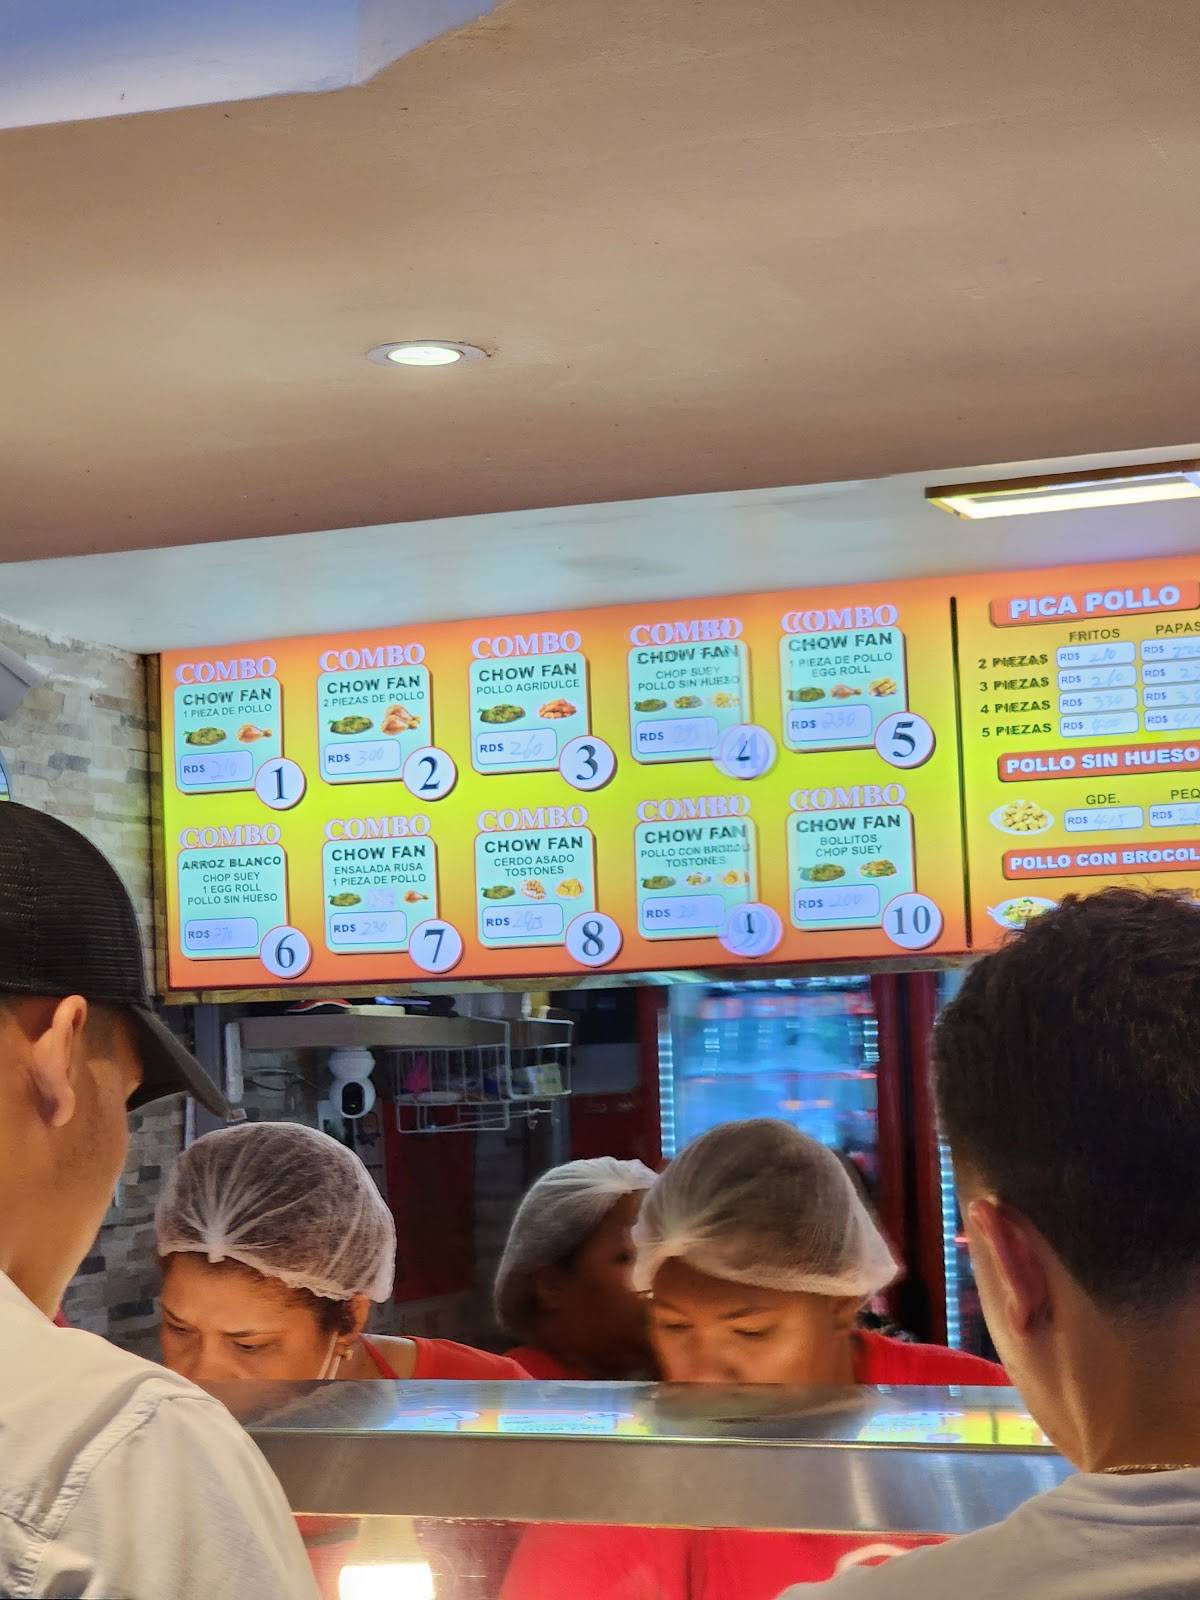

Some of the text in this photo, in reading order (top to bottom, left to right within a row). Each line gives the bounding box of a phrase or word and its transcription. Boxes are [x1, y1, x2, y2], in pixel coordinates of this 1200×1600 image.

[1010, 585, 1180, 619] PICA POLLO
[781, 604, 898, 633] COMBO
[630, 617, 743, 646] COMBO
[1069, 628, 1120, 642] FRITOS
[471, 630, 581, 659] COMBO
[789, 633, 892, 651] CHOW FAN
[320, 643, 425, 672] COMBO
[637, 645, 738, 664] CHOW FAN
[798, 657, 831, 667] PIEZA
[835, 655, 850, 664] DE
[854, 652, 892, 663] POLLO
[978, 654, 1048, 669] 2 PIEZAS
[176, 656, 276, 684] COMBO
[479, 663, 576, 681] CHOW FAN
[656, 666, 720, 679] CHOP SUEY
[812, 665, 871, 677] EGG ROLL
[327, 675, 420, 694] CHOW FAN
[477, 679, 580, 694] POLLO AGRIDULCE
[638, 681, 675, 691] POLLO
[679, 679, 697, 688] SIN
[980, 677, 1049, 691] 3 PIEZAS
[183, 688, 272, 705] CHOW FAN
[324, 691, 424, 707] 2 PIEZAS DE POLLO
[191, 708, 219, 718] PIEZA
[222, 707, 235, 715] DE
[239, 704, 272, 714] POLLO
[981, 700, 1050, 713] 4 PIEZAS
[982, 723, 1051, 737] 5 PIEZAS
[892, 721, 916, 757] 5
[577, 744, 598, 780] 3
[1007, 747, 1199, 774] POLLO SIN HUESO
[418, 757, 440, 791] 2
[272, 766, 287, 801] 1
[790, 783, 905, 811] COMBO
[1086, 794, 1120, 805] GDE.
[637, 794, 750, 822] COMBO
[477, 804, 588, 832] COMBO
[797, 815, 900, 832] CHOW FAN
[179, 823, 281, 848] COMBO
[324, 814, 431, 840] COMBO
[645, 824, 746, 844] CHOW FAN
[485, 835, 583, 853] CHOW FAN
[820, 834, 878, 846] BOLLITOS
[332, 845, 425, 861] CHOW FAN
[641, 848, 675, 858] POLLO
[678, 847, 701, 856] CON
[816, 845, 882, 857] CHOP SUEY
[182, 856, 281, 870] ARROZ BLANCO
[334, 862, 423, 875] ENSALADA RUSA
[494, 854, 575, 867] CERDO ASADO
[666, 856, 727, 868] TOSTONES
[1010, 854, 1071, 870] POLLO
[1076, 852, 1117, 866] CON
[203, 872, 260, 883] CHOP SUEY
[505, 865, 564, 877] TOSTONES
[211, 885, 232, 893] EGG
[235, 883, 261, 892] ROLL
[341, 876, 371, 886] PIEZA
[374, 875, 388, 884] DE
[391, 874, 426, 883] POLLO
[188, 893, 278, 905] POLLO SIN HUESO
[893, 905, 930, 935] 10
[424, 928, 445, 964] 7
[583, 920, 603, 956] 8
[275, 933, 295, 968] 6
